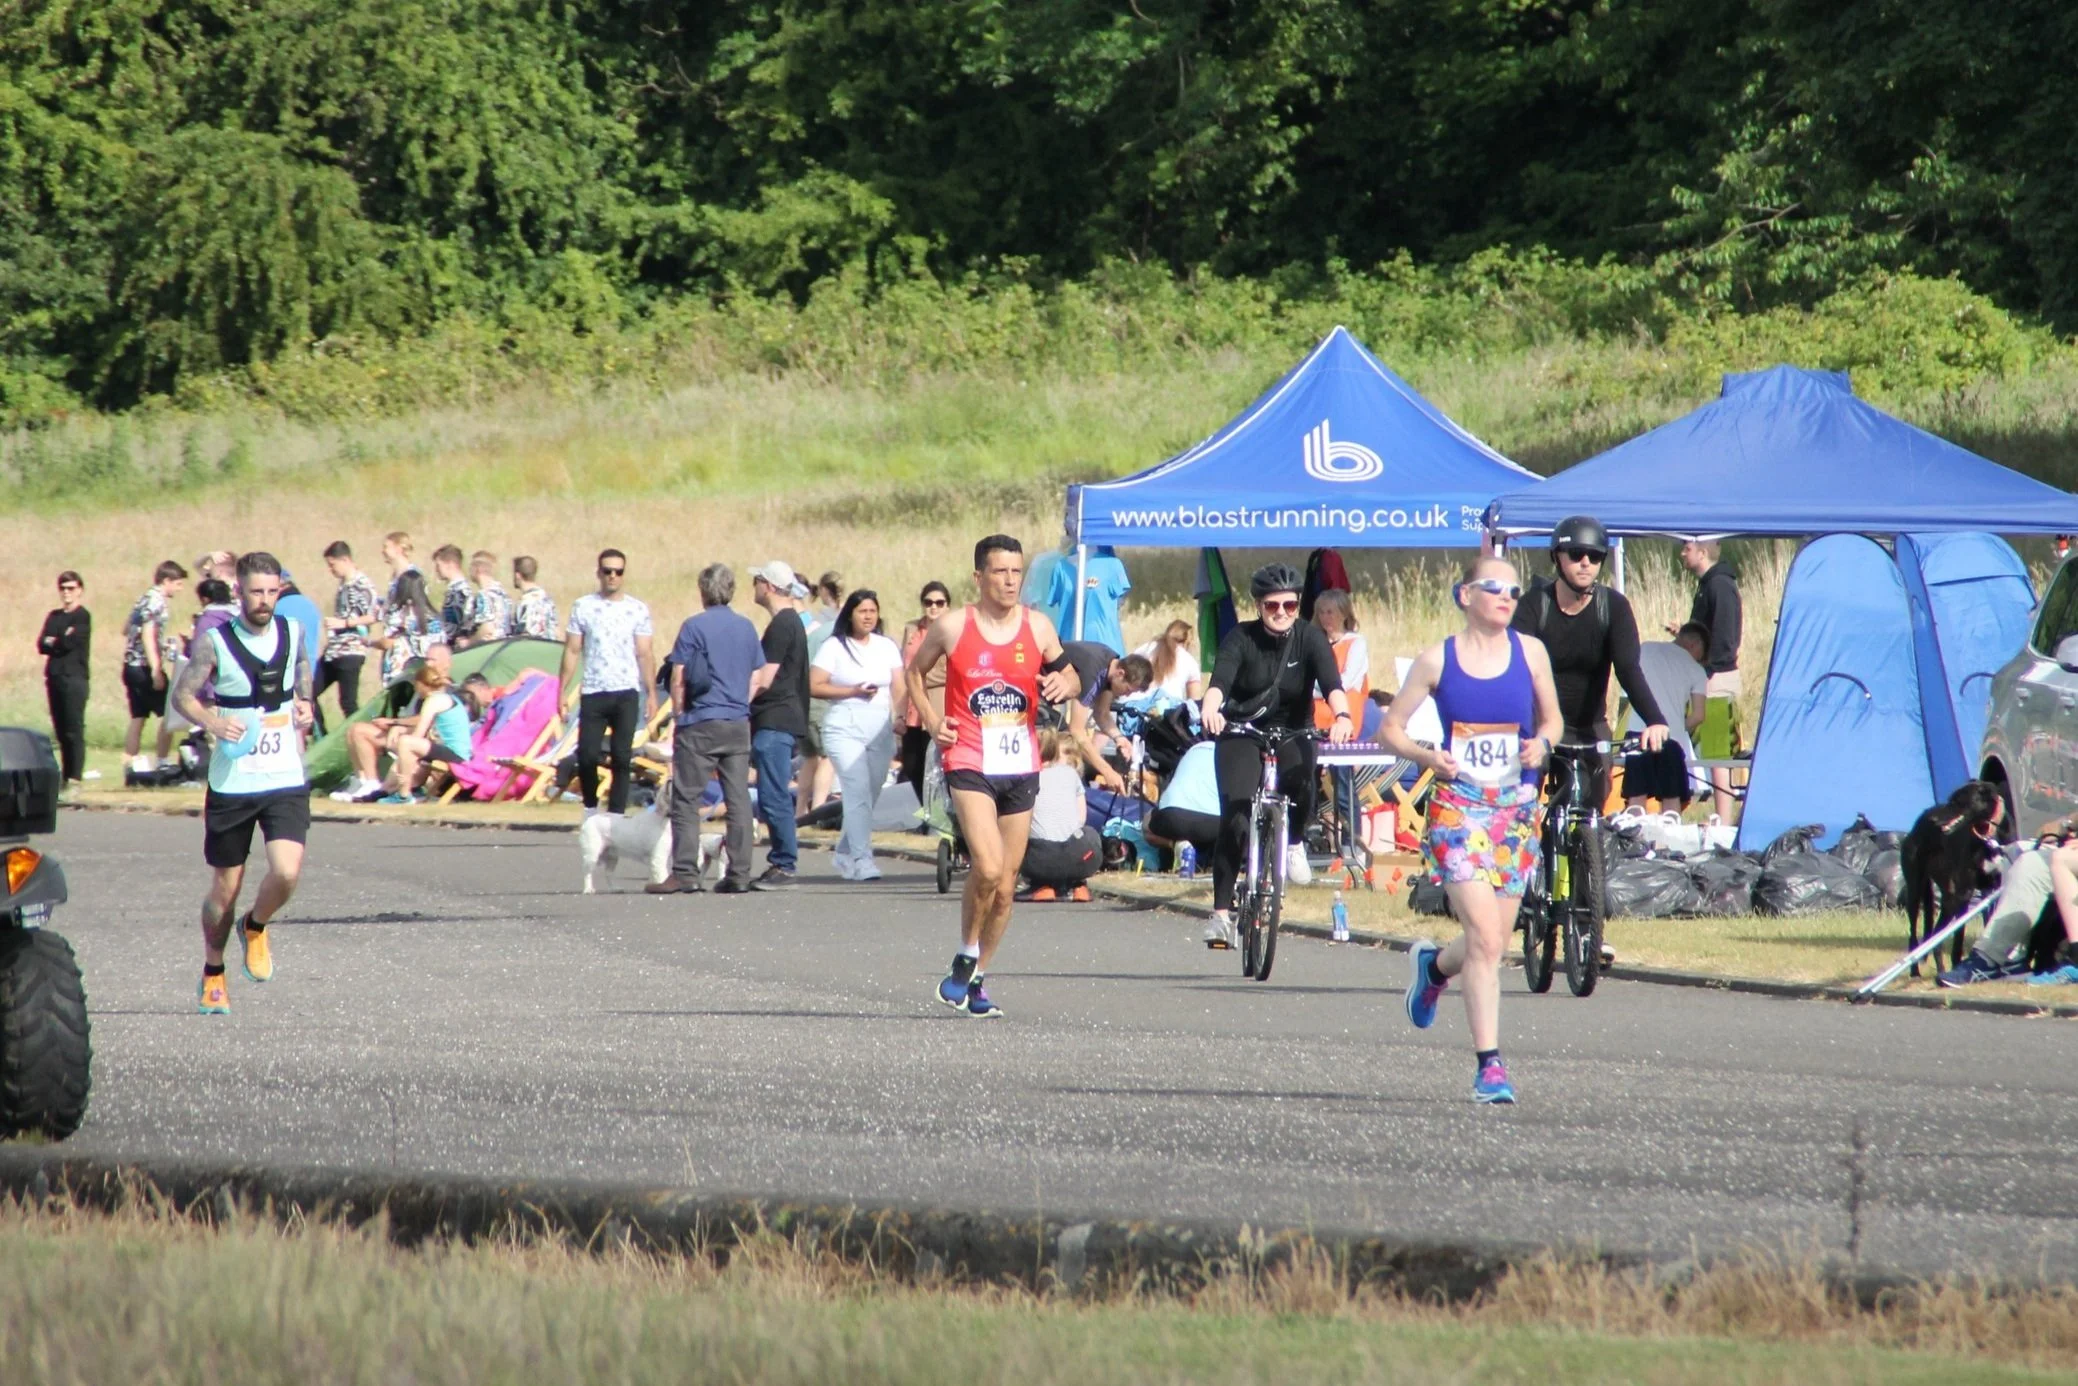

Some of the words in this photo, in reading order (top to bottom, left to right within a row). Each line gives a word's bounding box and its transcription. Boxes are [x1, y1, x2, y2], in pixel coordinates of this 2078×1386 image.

[1112, 504, 1449, 533] www.blastrunning.co.uk
[977, 693, 1022, 706] Estrella
[999, 731, 1021, 755] 46
[1464, 738, 1508, 768] 484
